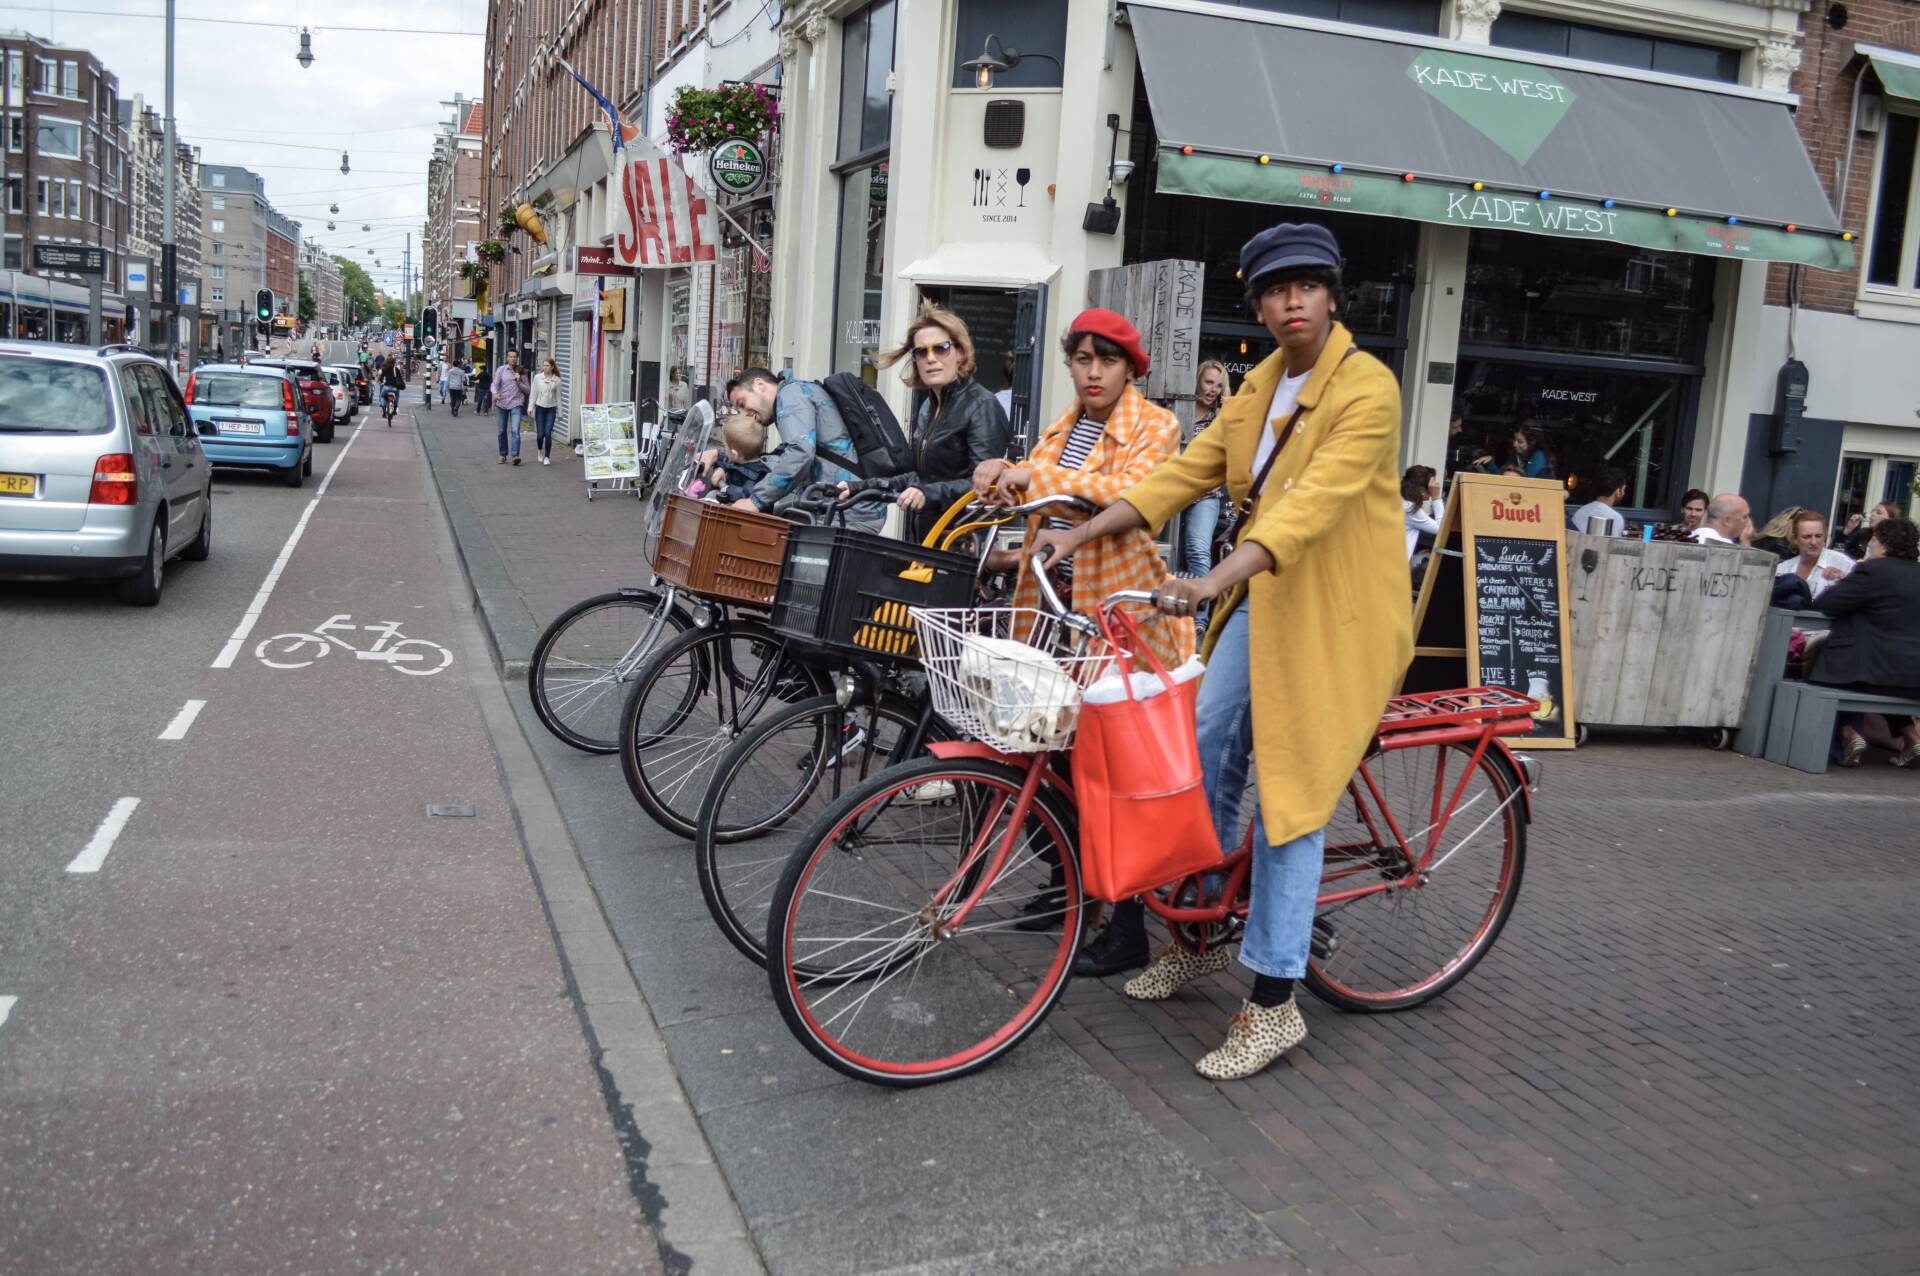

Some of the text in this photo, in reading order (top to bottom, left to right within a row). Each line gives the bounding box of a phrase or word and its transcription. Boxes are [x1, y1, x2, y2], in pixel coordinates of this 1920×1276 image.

[1414, 65, 1565, 103] KADE WEST
[716, 160, 761, 173] Heineken
[618, 158, 716, 264] SALE
[982, 215, 1017, 223] SINCE 2014
[1447, 193, 1617, 234] KADE WEST
[1156, 264, 1169, 313] KADE
[1172, 268, 1197, 371] KADE WEST
[1224, 362, 1253, 374] KADE
[1541, 389, 1598, 402] KADE WEST
[1491, 499, 1541, 523] Duvel
[1498, 546, 1534, 563] Lunch
[1630, 567, 1741, 598] KADE WEST
[1480, 667, 1505, 679] LIVE
